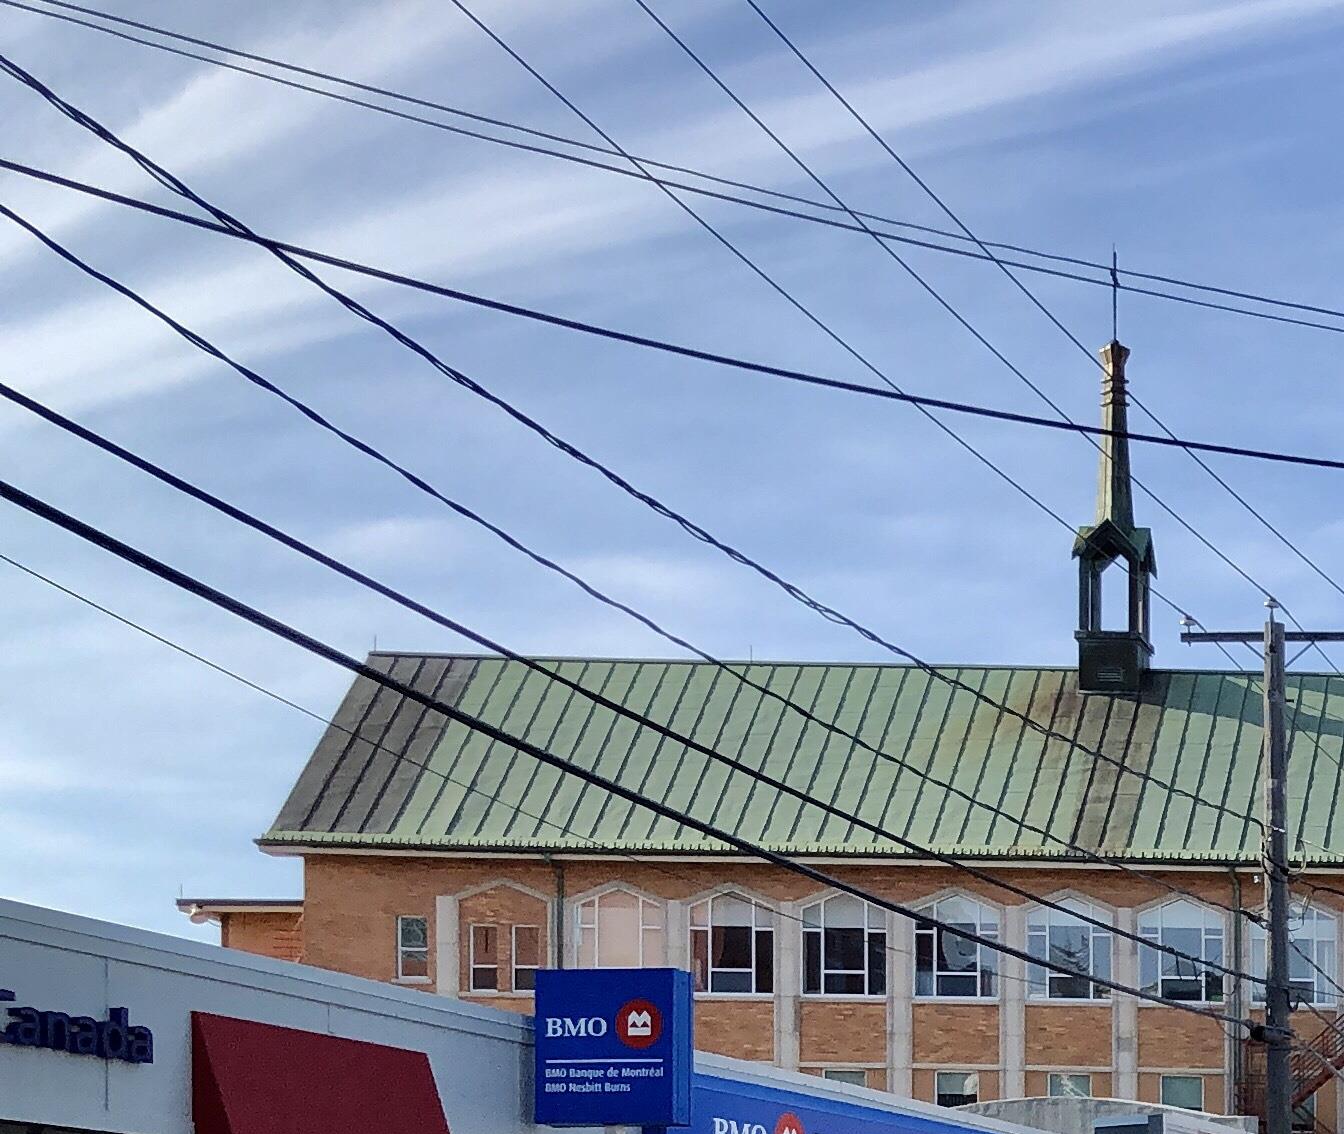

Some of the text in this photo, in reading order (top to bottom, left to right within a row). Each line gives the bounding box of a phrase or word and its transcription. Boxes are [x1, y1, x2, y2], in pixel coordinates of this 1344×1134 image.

[545, 1017, 607, 1037] BMO
[545, 1066, 664, 1080] BMO Banque de Montréal
[545, 1082, 631, 1092] BMO Nesbitt Burns
